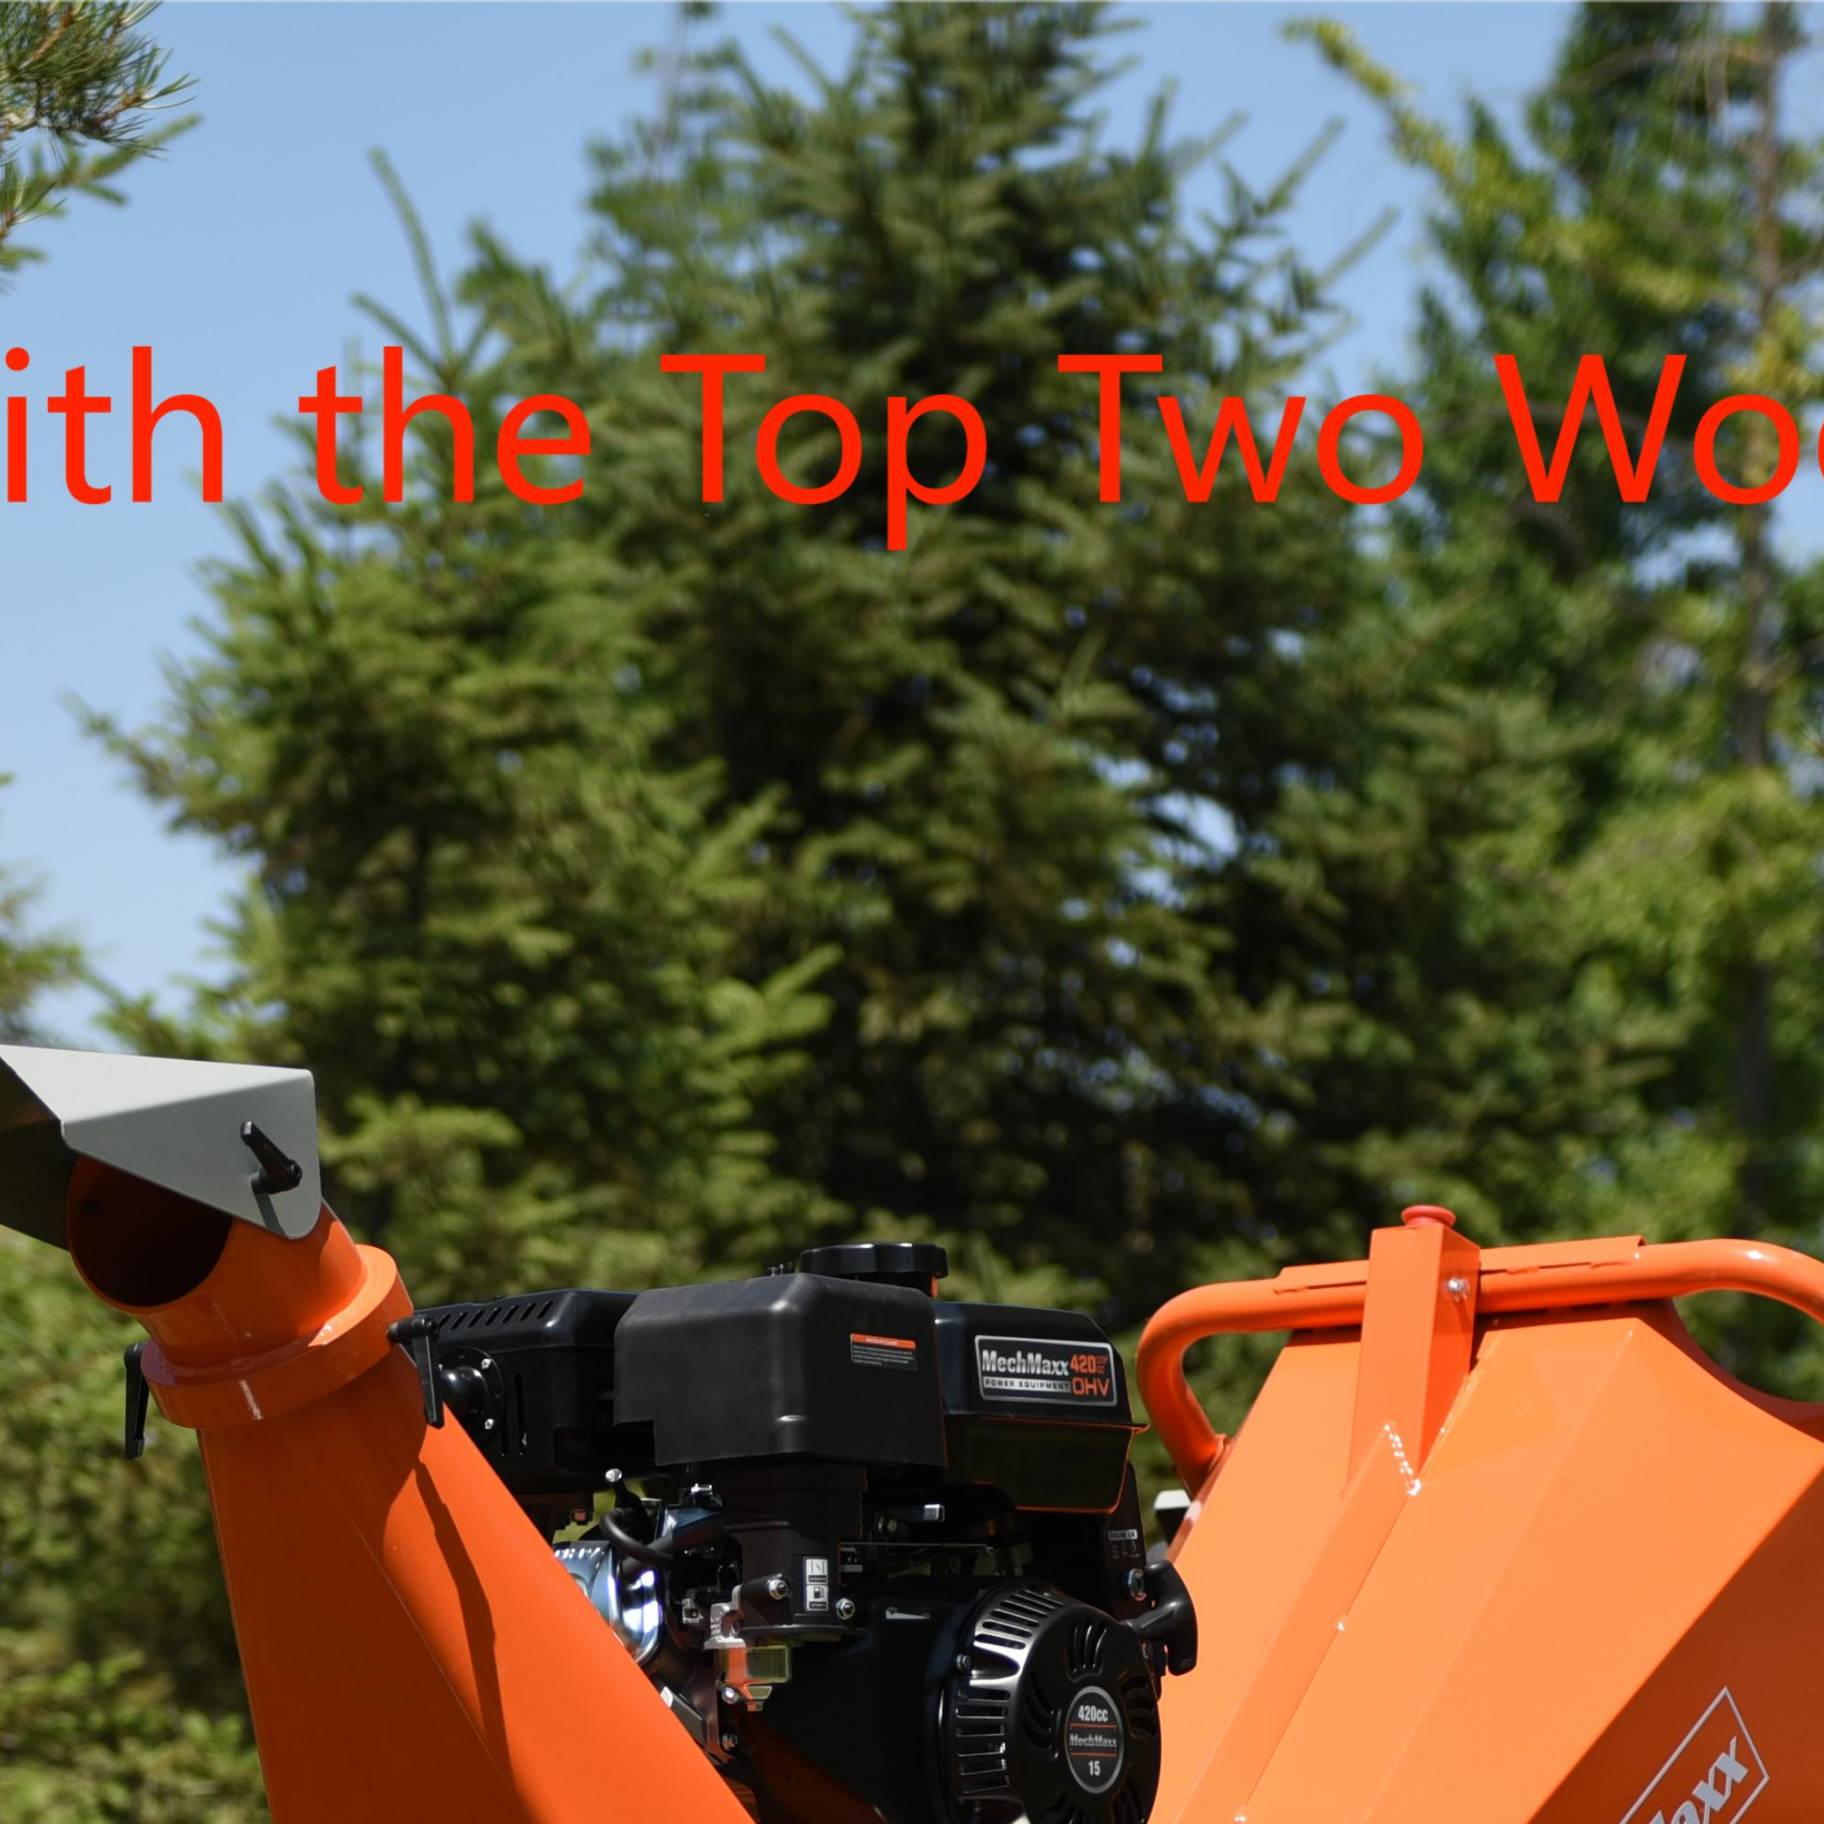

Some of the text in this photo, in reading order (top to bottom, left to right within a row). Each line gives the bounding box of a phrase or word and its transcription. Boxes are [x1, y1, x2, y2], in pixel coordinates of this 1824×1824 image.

[982, 1349, 1069, 1376] MechMaxx
[1071, 1354, 1096, 1374] 420
[985, 1379, 1069, 1390] POWER EQUIPMENT
[1072, 1377, 1110, 1397] OHV
[1078, 1705, 1108, 1722] 420cc
[1088, 1760, 1101, 1776] 15
